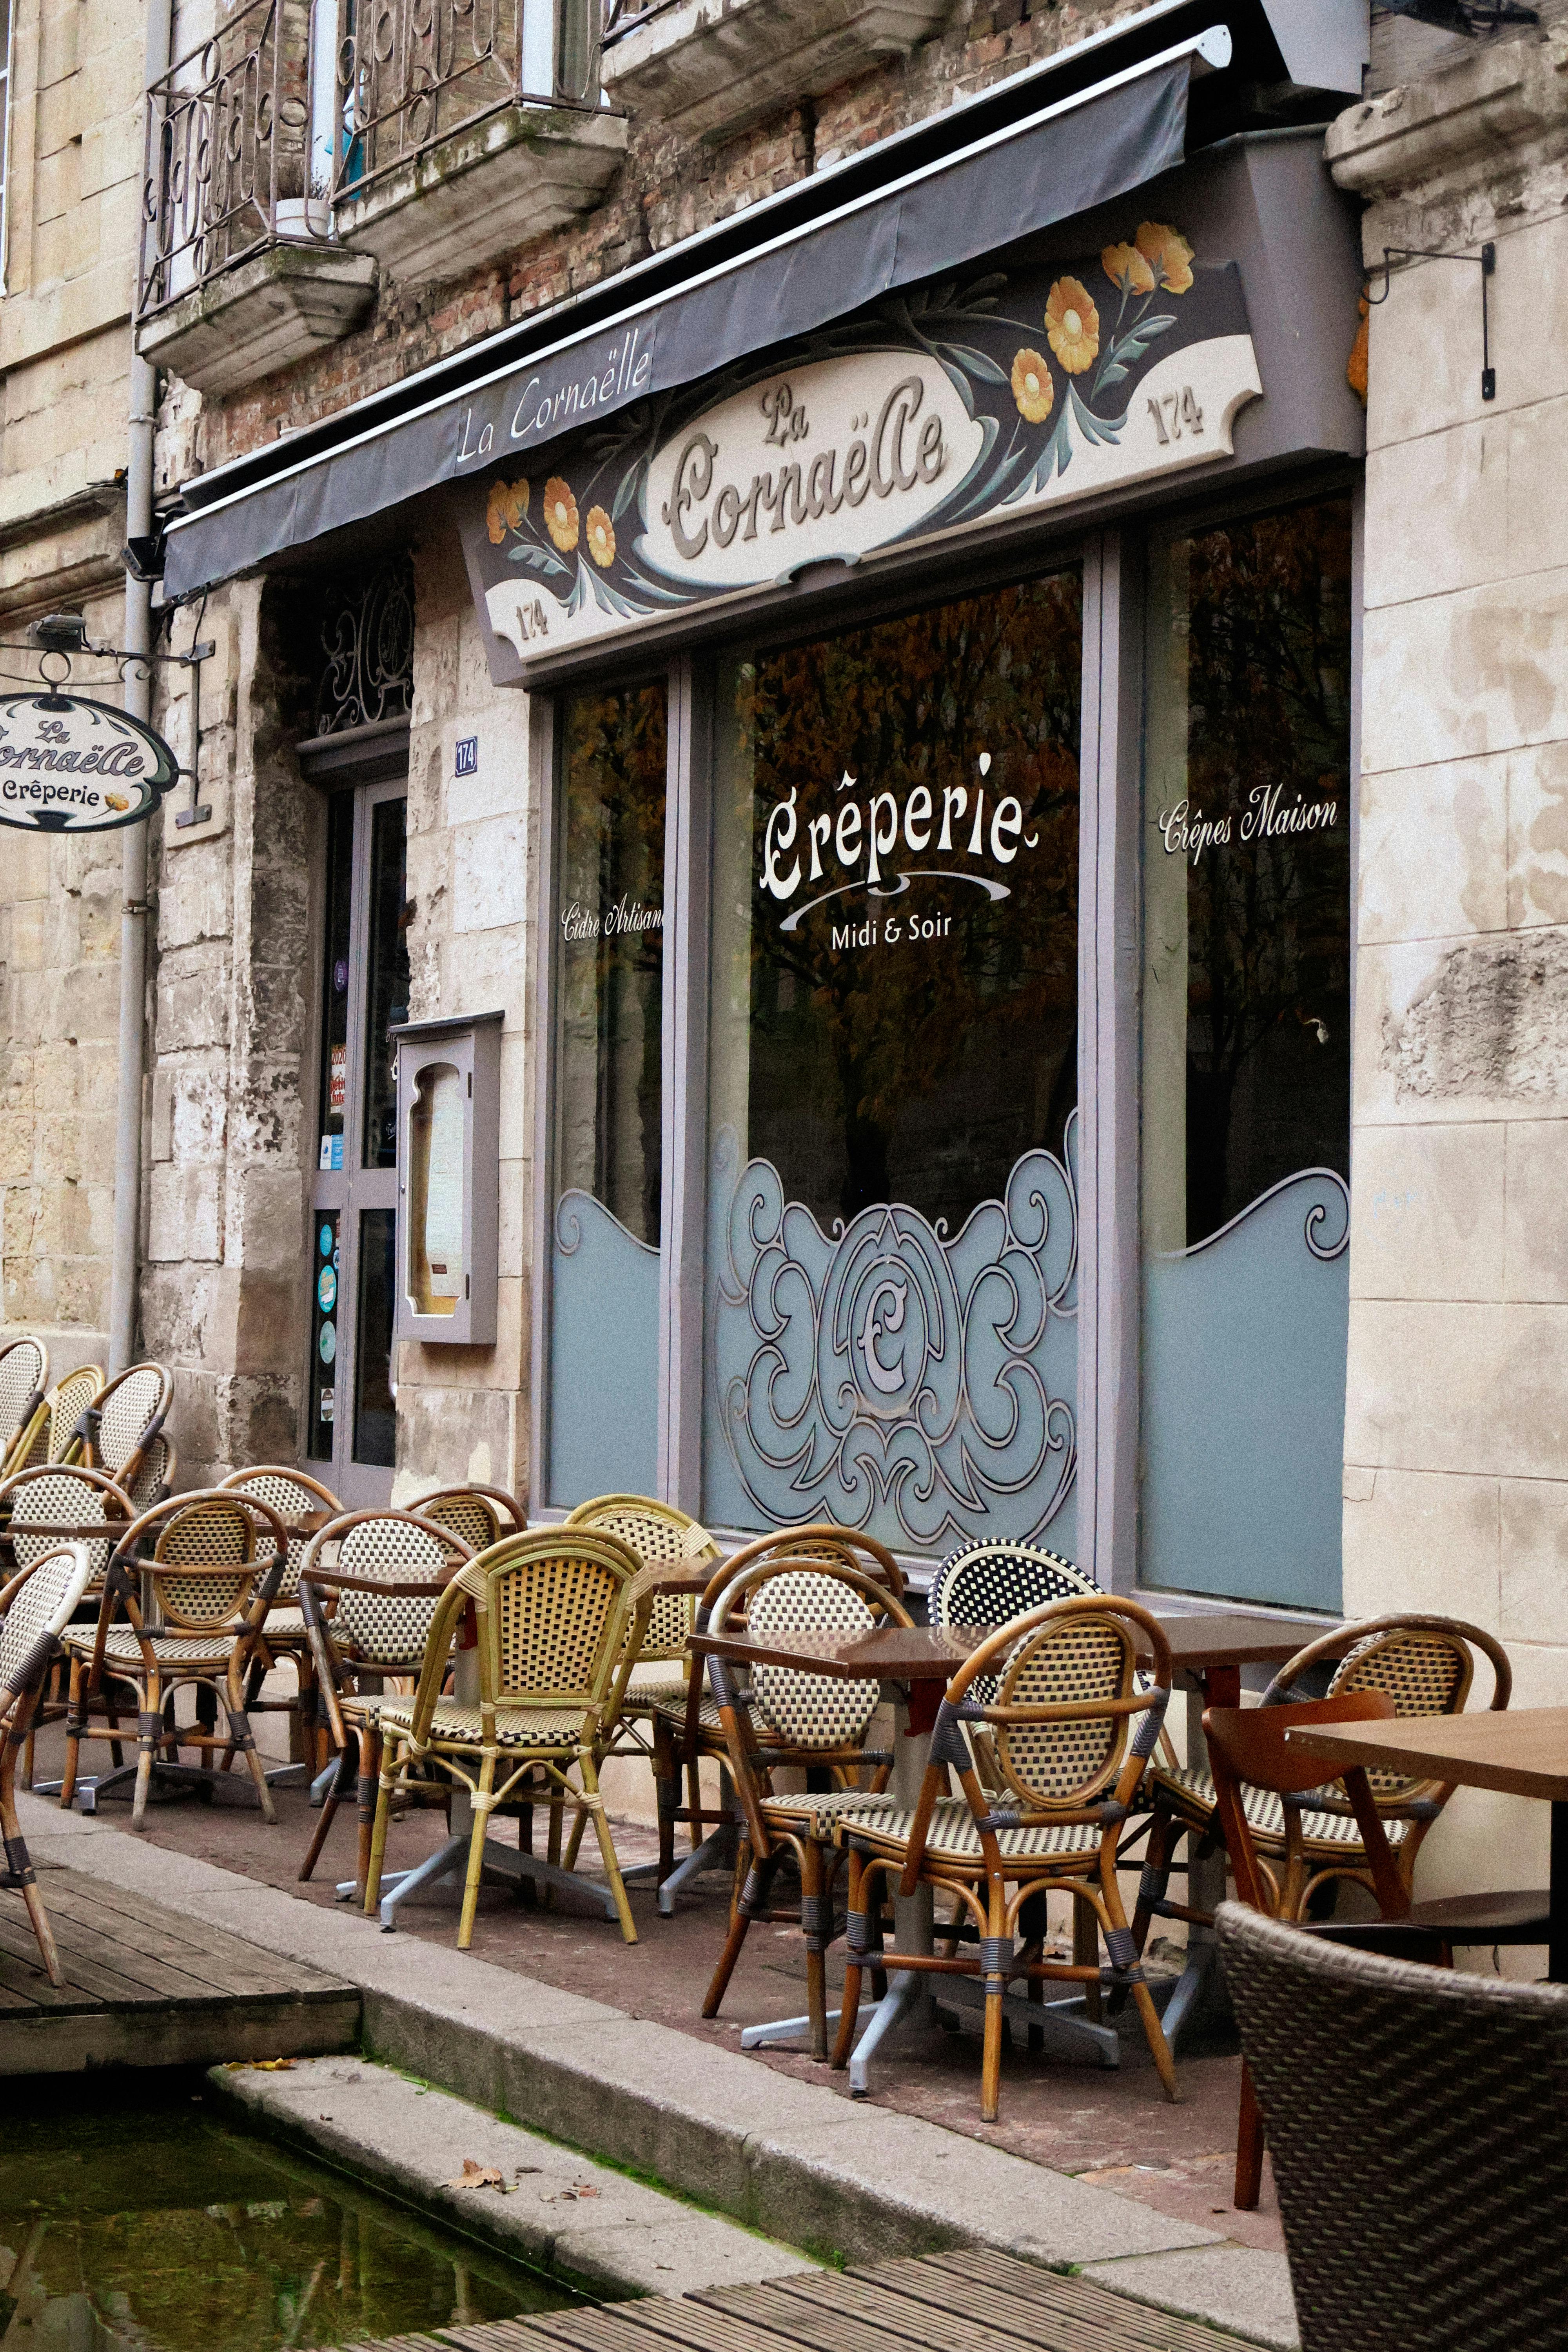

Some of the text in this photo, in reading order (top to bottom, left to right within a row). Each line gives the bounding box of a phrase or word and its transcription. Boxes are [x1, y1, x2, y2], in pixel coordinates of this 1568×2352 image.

[457, 328, 650, 463] La Cornaëlle
[758, 383, 809, 448] La
[1147, 385, 1204, 445] 174
[661, 375, 946, 560] Cornaëlle
[515, 599, 548, 641] 174
[0, 733, 145, 777] ornaëlle
[35, 720, 70, 744] La
[458, 742, 474, 770] 174
[2, 779, 100, 806] Crêperie
[1159, 783, 1338, 866] Crêpes Maison
[561, 892, 663, 941] Cidre Artisan
[832, 911, 952, 950] Midi & Soir
